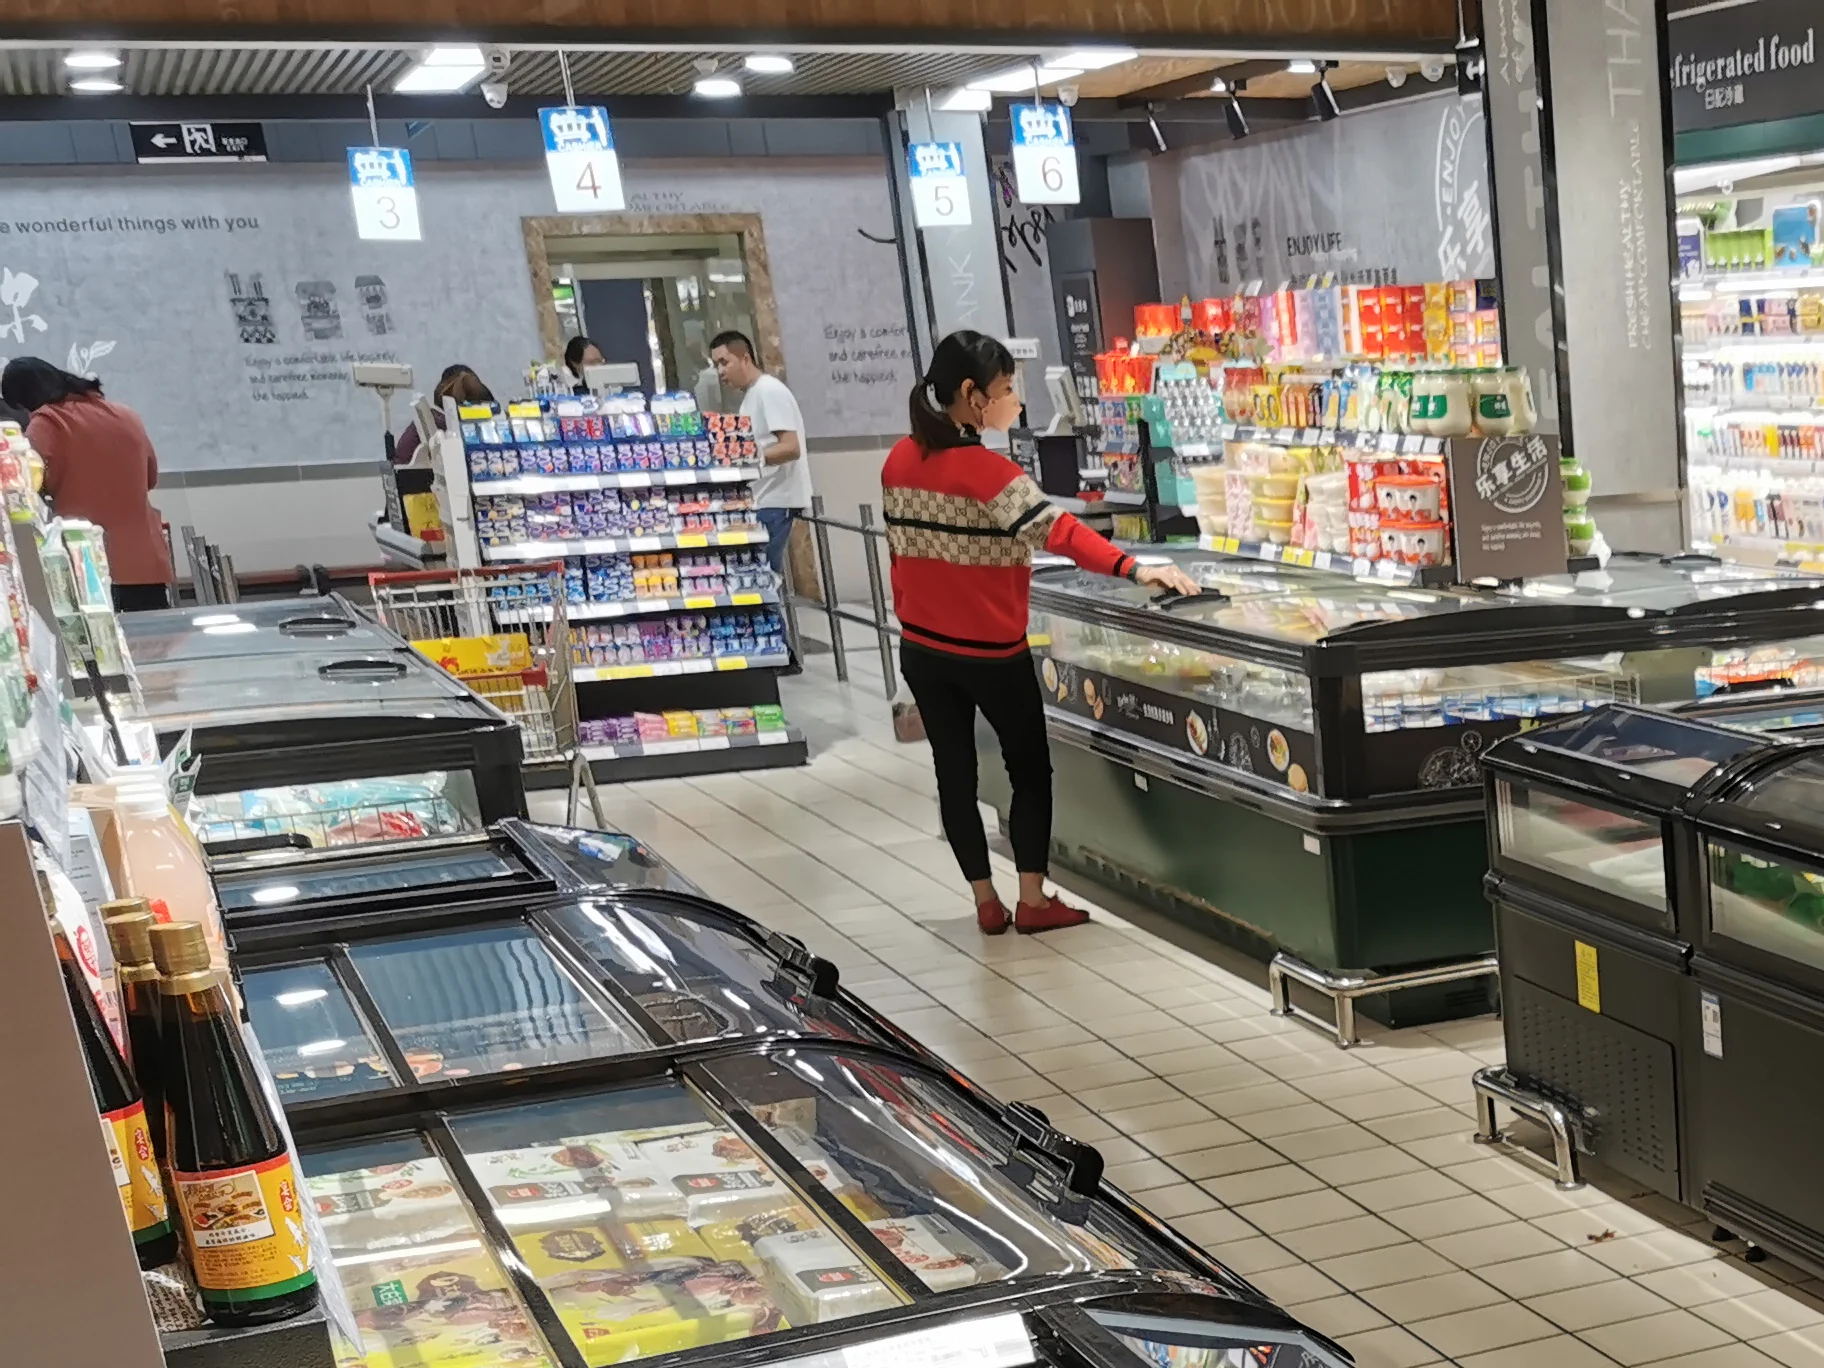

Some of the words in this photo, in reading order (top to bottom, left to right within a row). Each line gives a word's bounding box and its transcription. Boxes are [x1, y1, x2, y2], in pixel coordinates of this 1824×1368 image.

[1770, 28, 1815, 70] food
[576, 161, 602, 199] 4
[1042, 156, 1063, 192] 6
[376, 196, 401, 229] 3
[934, 185, 954, 216] 5
[15, 217, 113, 234] wonderful
[118, 216, 177, 234] things
[181, 215, 220, 230] with
[225, 217, 260, 233] you
[1475, 435, 1548, 500] 乐享生活
